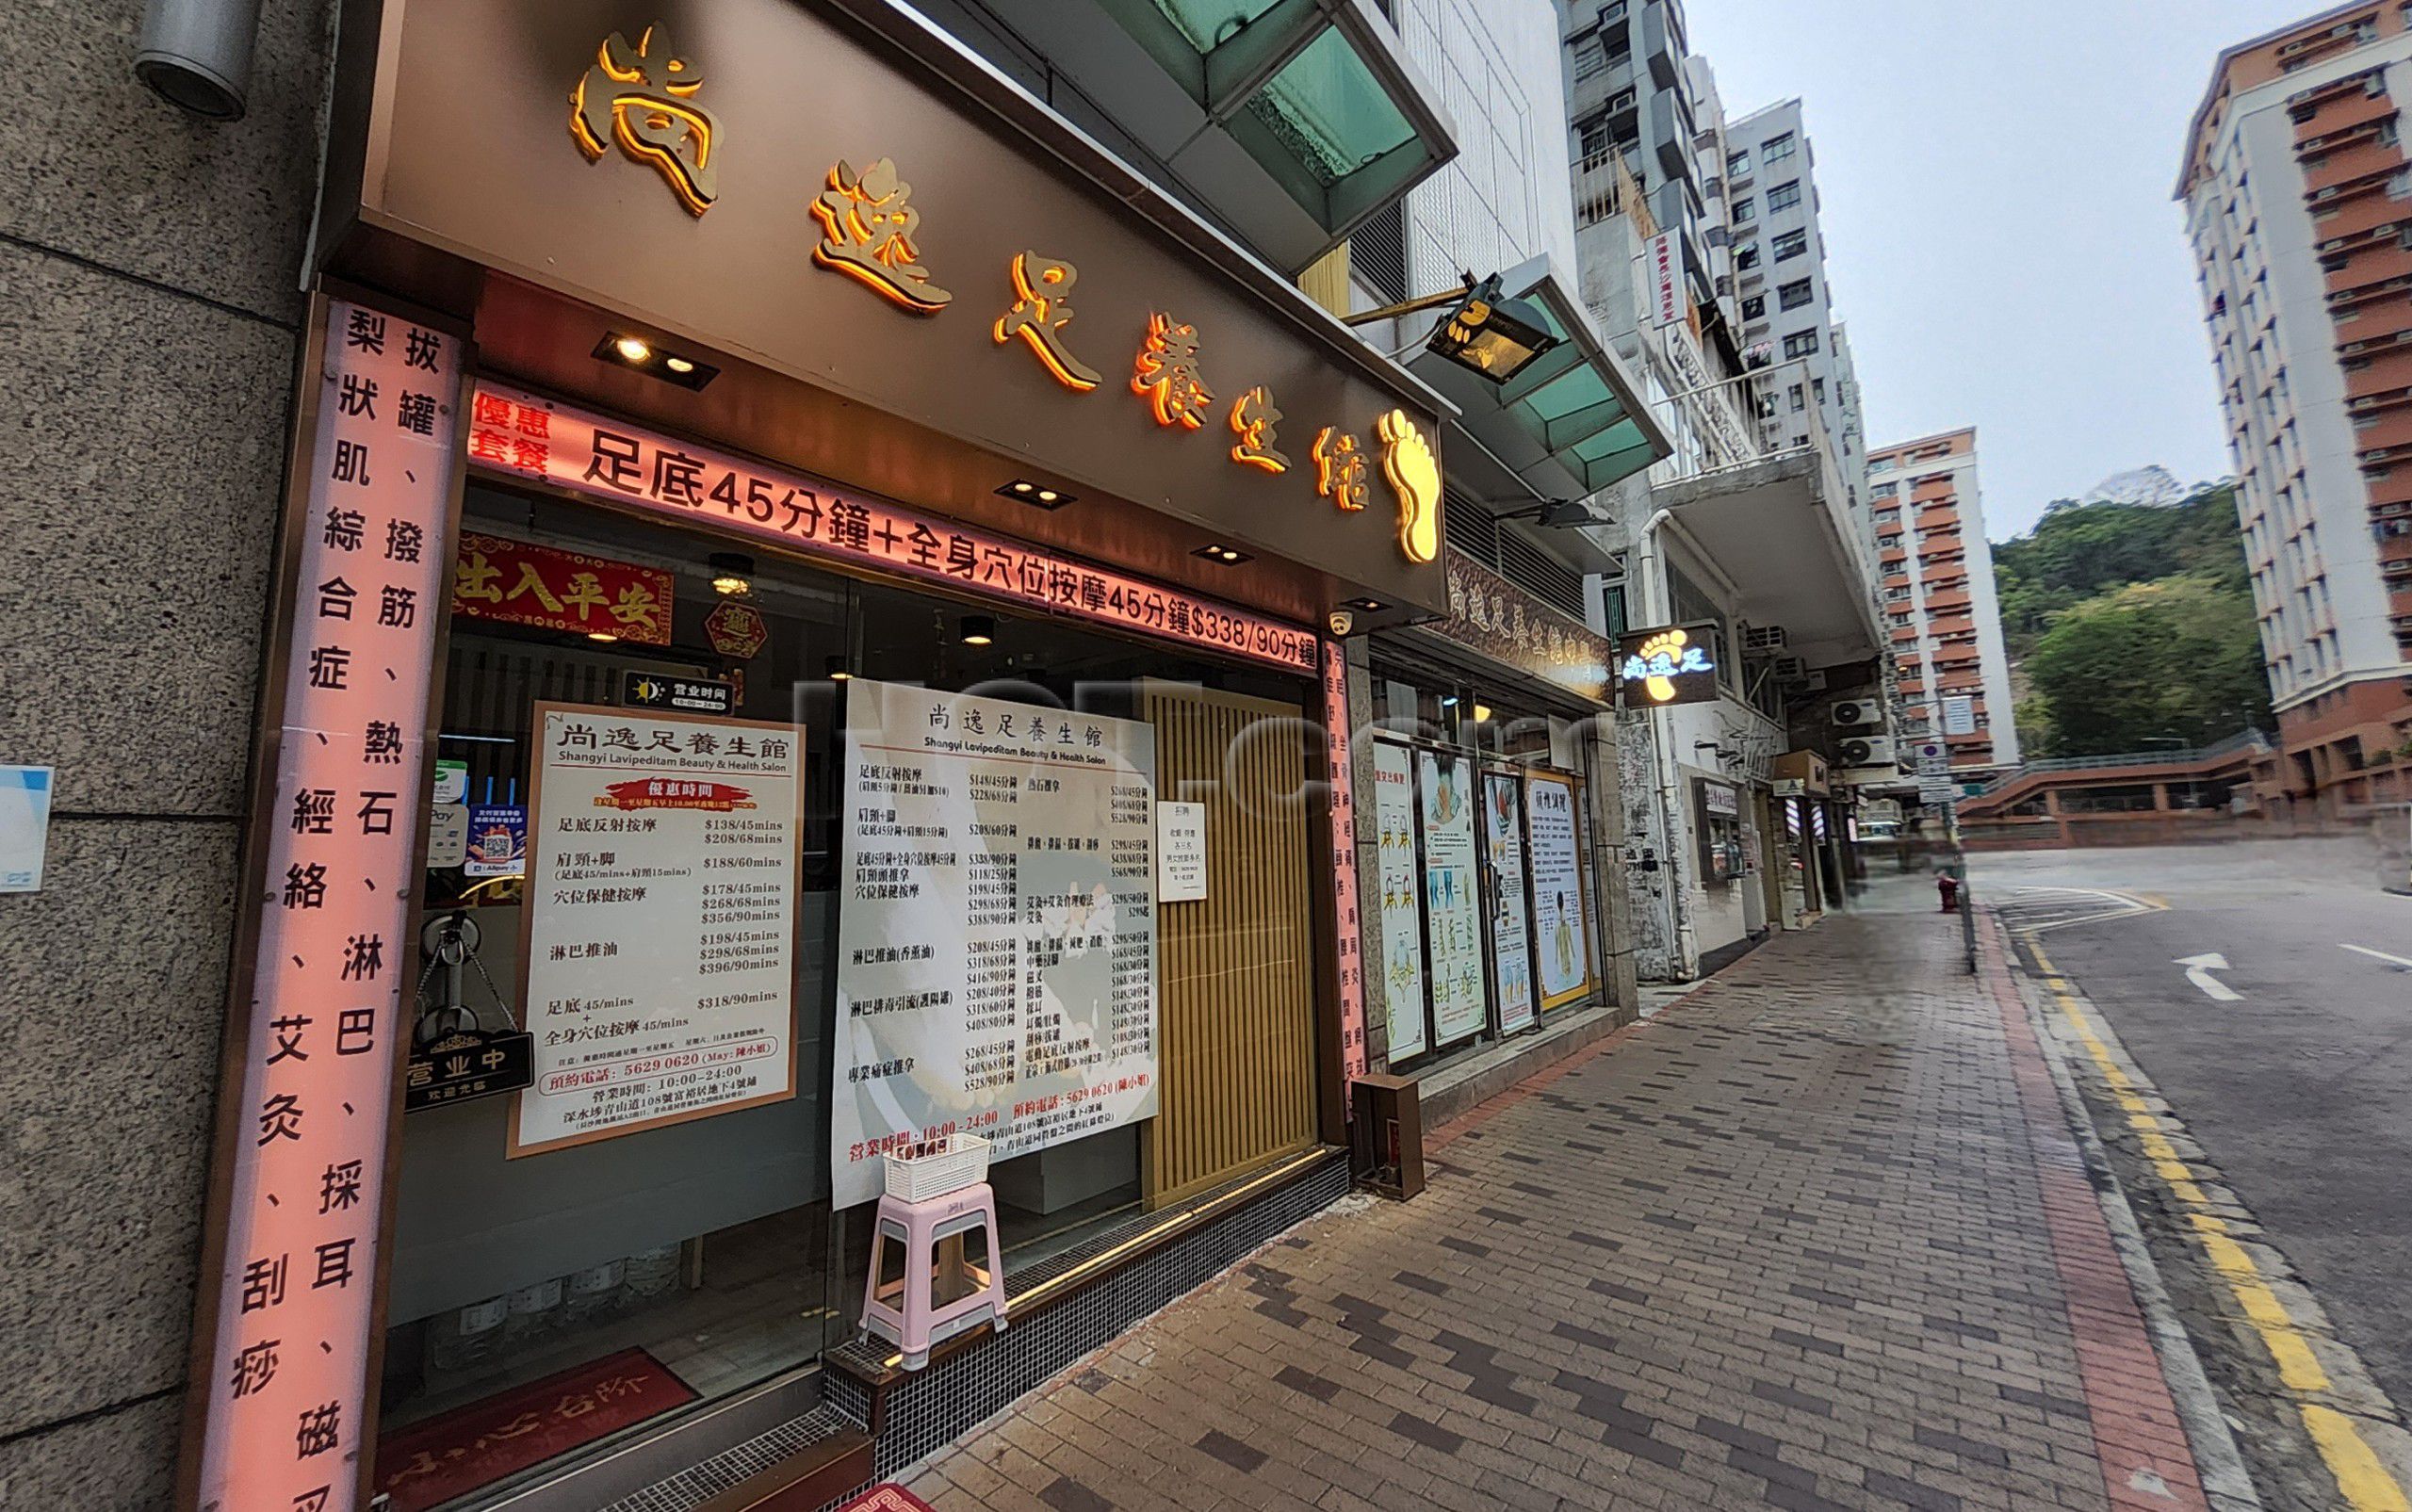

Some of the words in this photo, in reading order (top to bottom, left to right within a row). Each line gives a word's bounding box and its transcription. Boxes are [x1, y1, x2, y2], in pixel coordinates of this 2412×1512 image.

[474, 392, 551, 440] 優惠
[471, 428, 549, 473] 套餐
[457, 552, 660, 629] 出入平安
[674, 683, 725, 700] 营业时间
[929, 703, 1102, 748] 尚逸足養生館
[557, 723, 789, 759] 尚逸足養生館
[924, 737, 963, 752] Shangyi
[1019, 747, 1049, 761] Beauty
[1051, 751, 1057, 759] &
[1059, 752, 1084, 763] Health
[1085, 756, 1106, 765] Salon
[559, 751, 607, 764] Shangyi
[680, 757, 714, 770] Beauty
[717, 760, 725, 769] &
[728, 760, 758, 771] Health
[761, 762, 786, 772] Salon
[859, 764, 922, 782] 足底反射按摩
[648, 782, 712, 796] 優惠時間
[558, 817, 657, 832] 足底反射按摩
[705, 820, 783, 830] $138/45mins
[705, 834, 782, 844] $208/68mins
[704, 857, 782, 868] $188/60mins
[553, 887, 647, 905] 穴位保健按摩
[702, 883, 781, 896] $178/45mins
[702, 897, 781, 910] $268/68mins
[701, 911, 780, 924] $356/90mins
[701, 931, 780, 945] $198/45mins
[550, 942, 618, 961] 淋巴推油
[700, 945, 779, 960] $298/68mins
[699, 959, 778, 974] $396/90mins
[546, 998, 580, 1016] 足底
[697, 991, 777, 1009] $318/90mins
[545, 1019, 641, 1047] 全身穴位按摩
[624, 1056, 661, 1077] 5629
[664, 1053, 699, 1070] 0620
[923, 1121, 956, 1141] 10:00
[967, 1111, 999, 1130] 24:00
[1066, 1088, 1089, 1106] 5629
